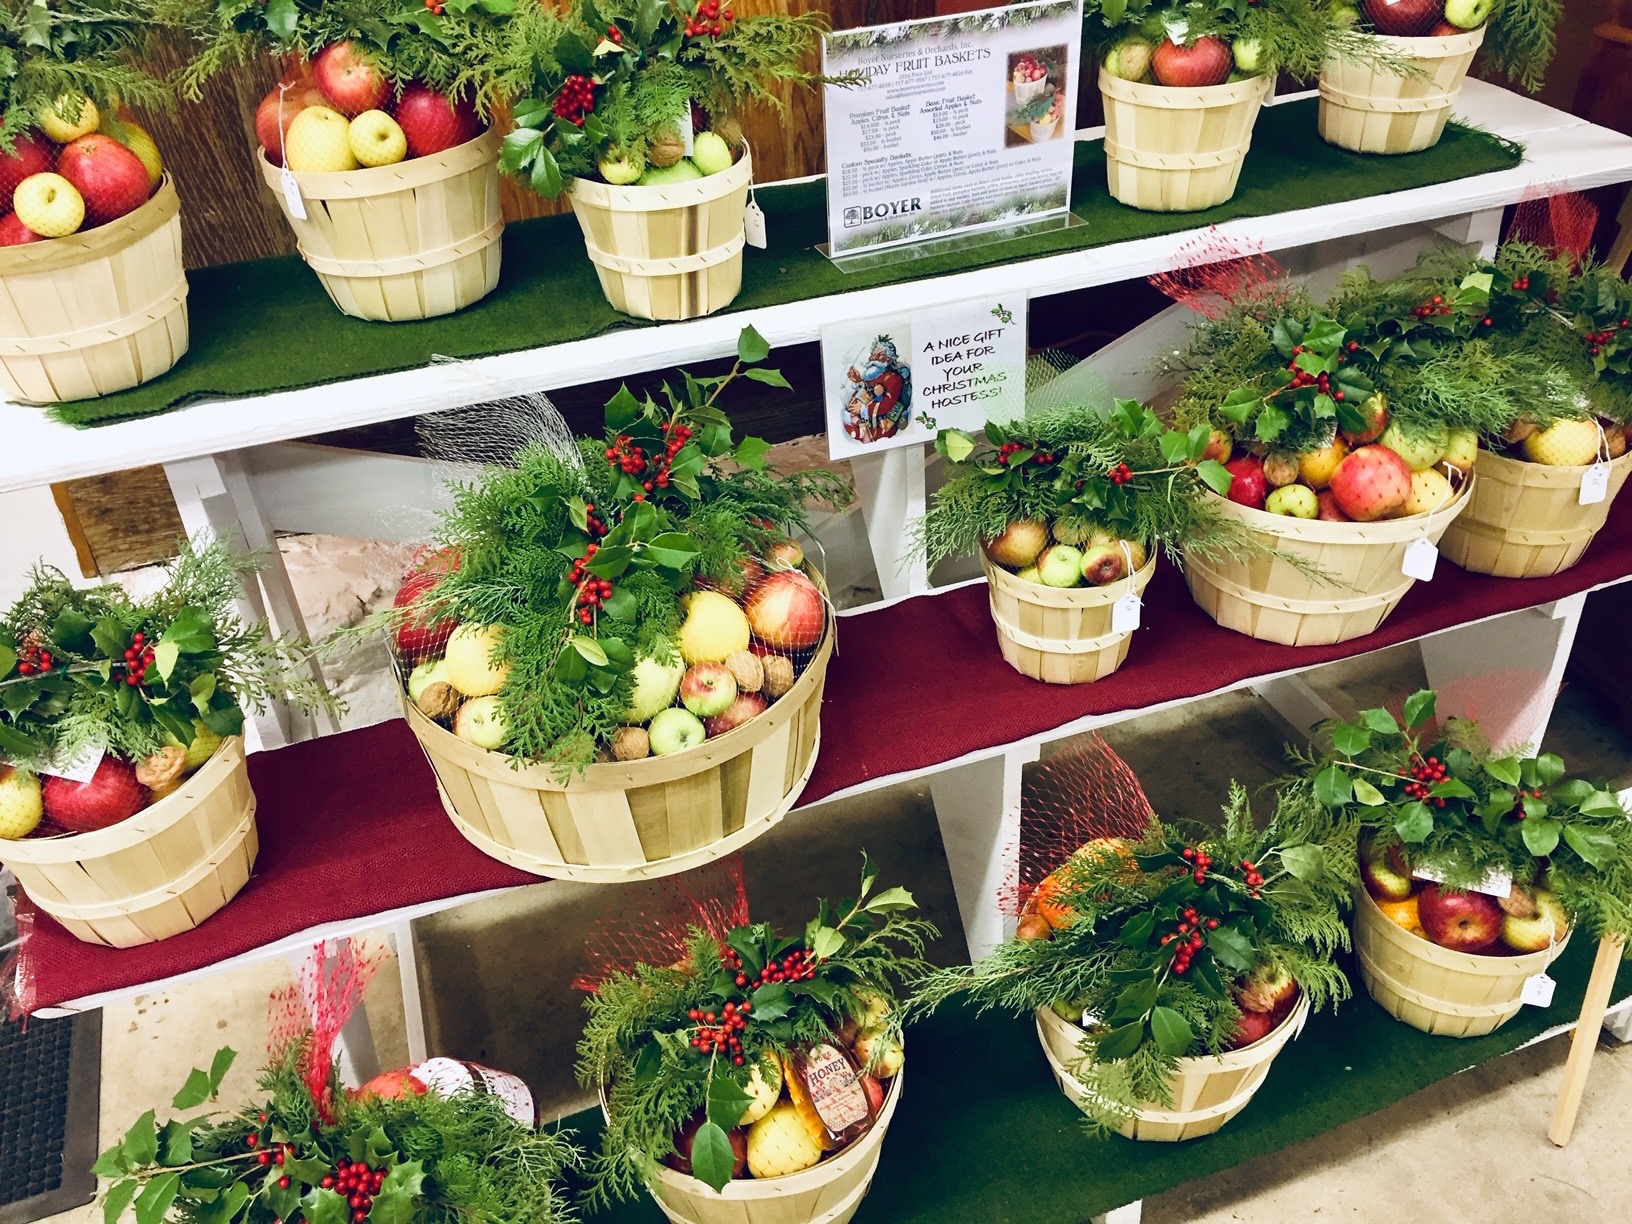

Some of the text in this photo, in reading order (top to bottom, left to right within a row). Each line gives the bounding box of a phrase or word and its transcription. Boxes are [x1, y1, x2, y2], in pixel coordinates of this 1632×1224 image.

[839, 48, 991, 78] HIDAY FRUIT BASKETS
[858, 56, 879, 65] Boyer
[881, 51, 915, 61] Nurseries
[925, 44, 958, 54] Orchards,
[849, 110, 874, 119] Premium
[891, 104, 910, 112] Basket
[920, 105, 942, 114] Assorted
[945, 102, 962, 110] Apples
[926, 99, 939, 107] Basic
[842, 152, 911, 169] Custom Specialty Baskets
[863, 197, 921, 220] BOYER
[923, 328, 1005, 353] A NICE GIFT
[931, 345, 996, 366] IDEA FOR
[942, 362, 985, 382] YOUR
[922, 371, 1008, 397] CHRISTMAS
[931, 386, 1002, 410] HOSTESS!
[808, 1058, 847, 1087] HONEY
